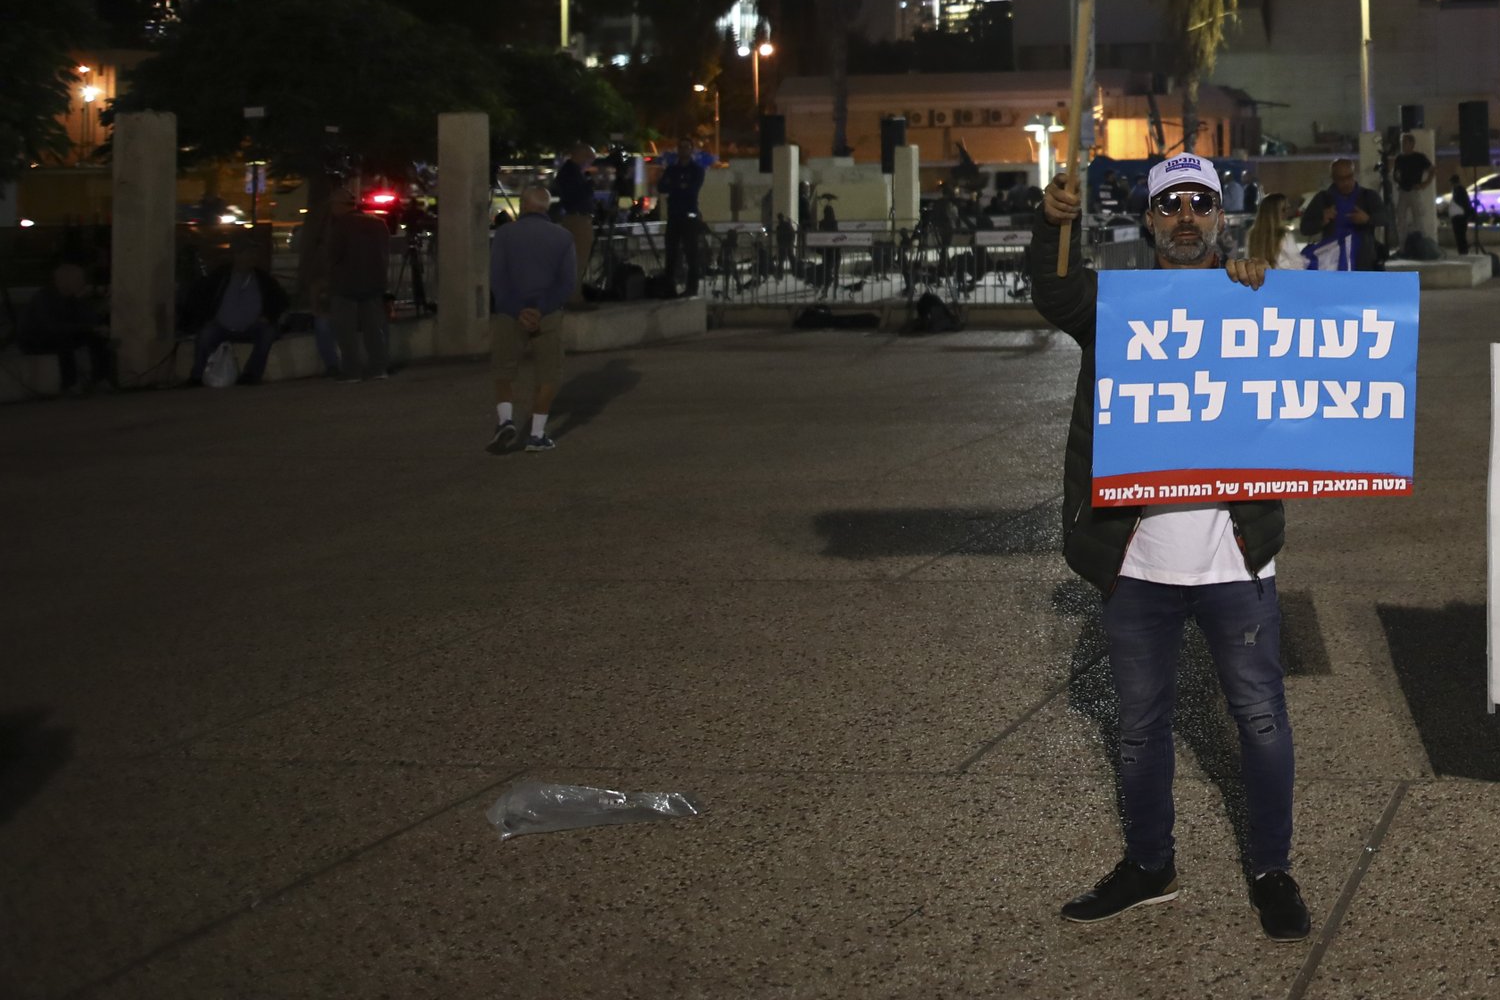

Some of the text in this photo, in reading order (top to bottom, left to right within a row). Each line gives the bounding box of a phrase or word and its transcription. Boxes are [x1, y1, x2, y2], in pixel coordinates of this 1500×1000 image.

[1127, 307, 1394, 360] לעולם לא
[1098, 371, 1405, 424] תצעד לבד!
[1099, 479, 1407, 500] מטה המאבק המשותף של המחנה הלאומי
